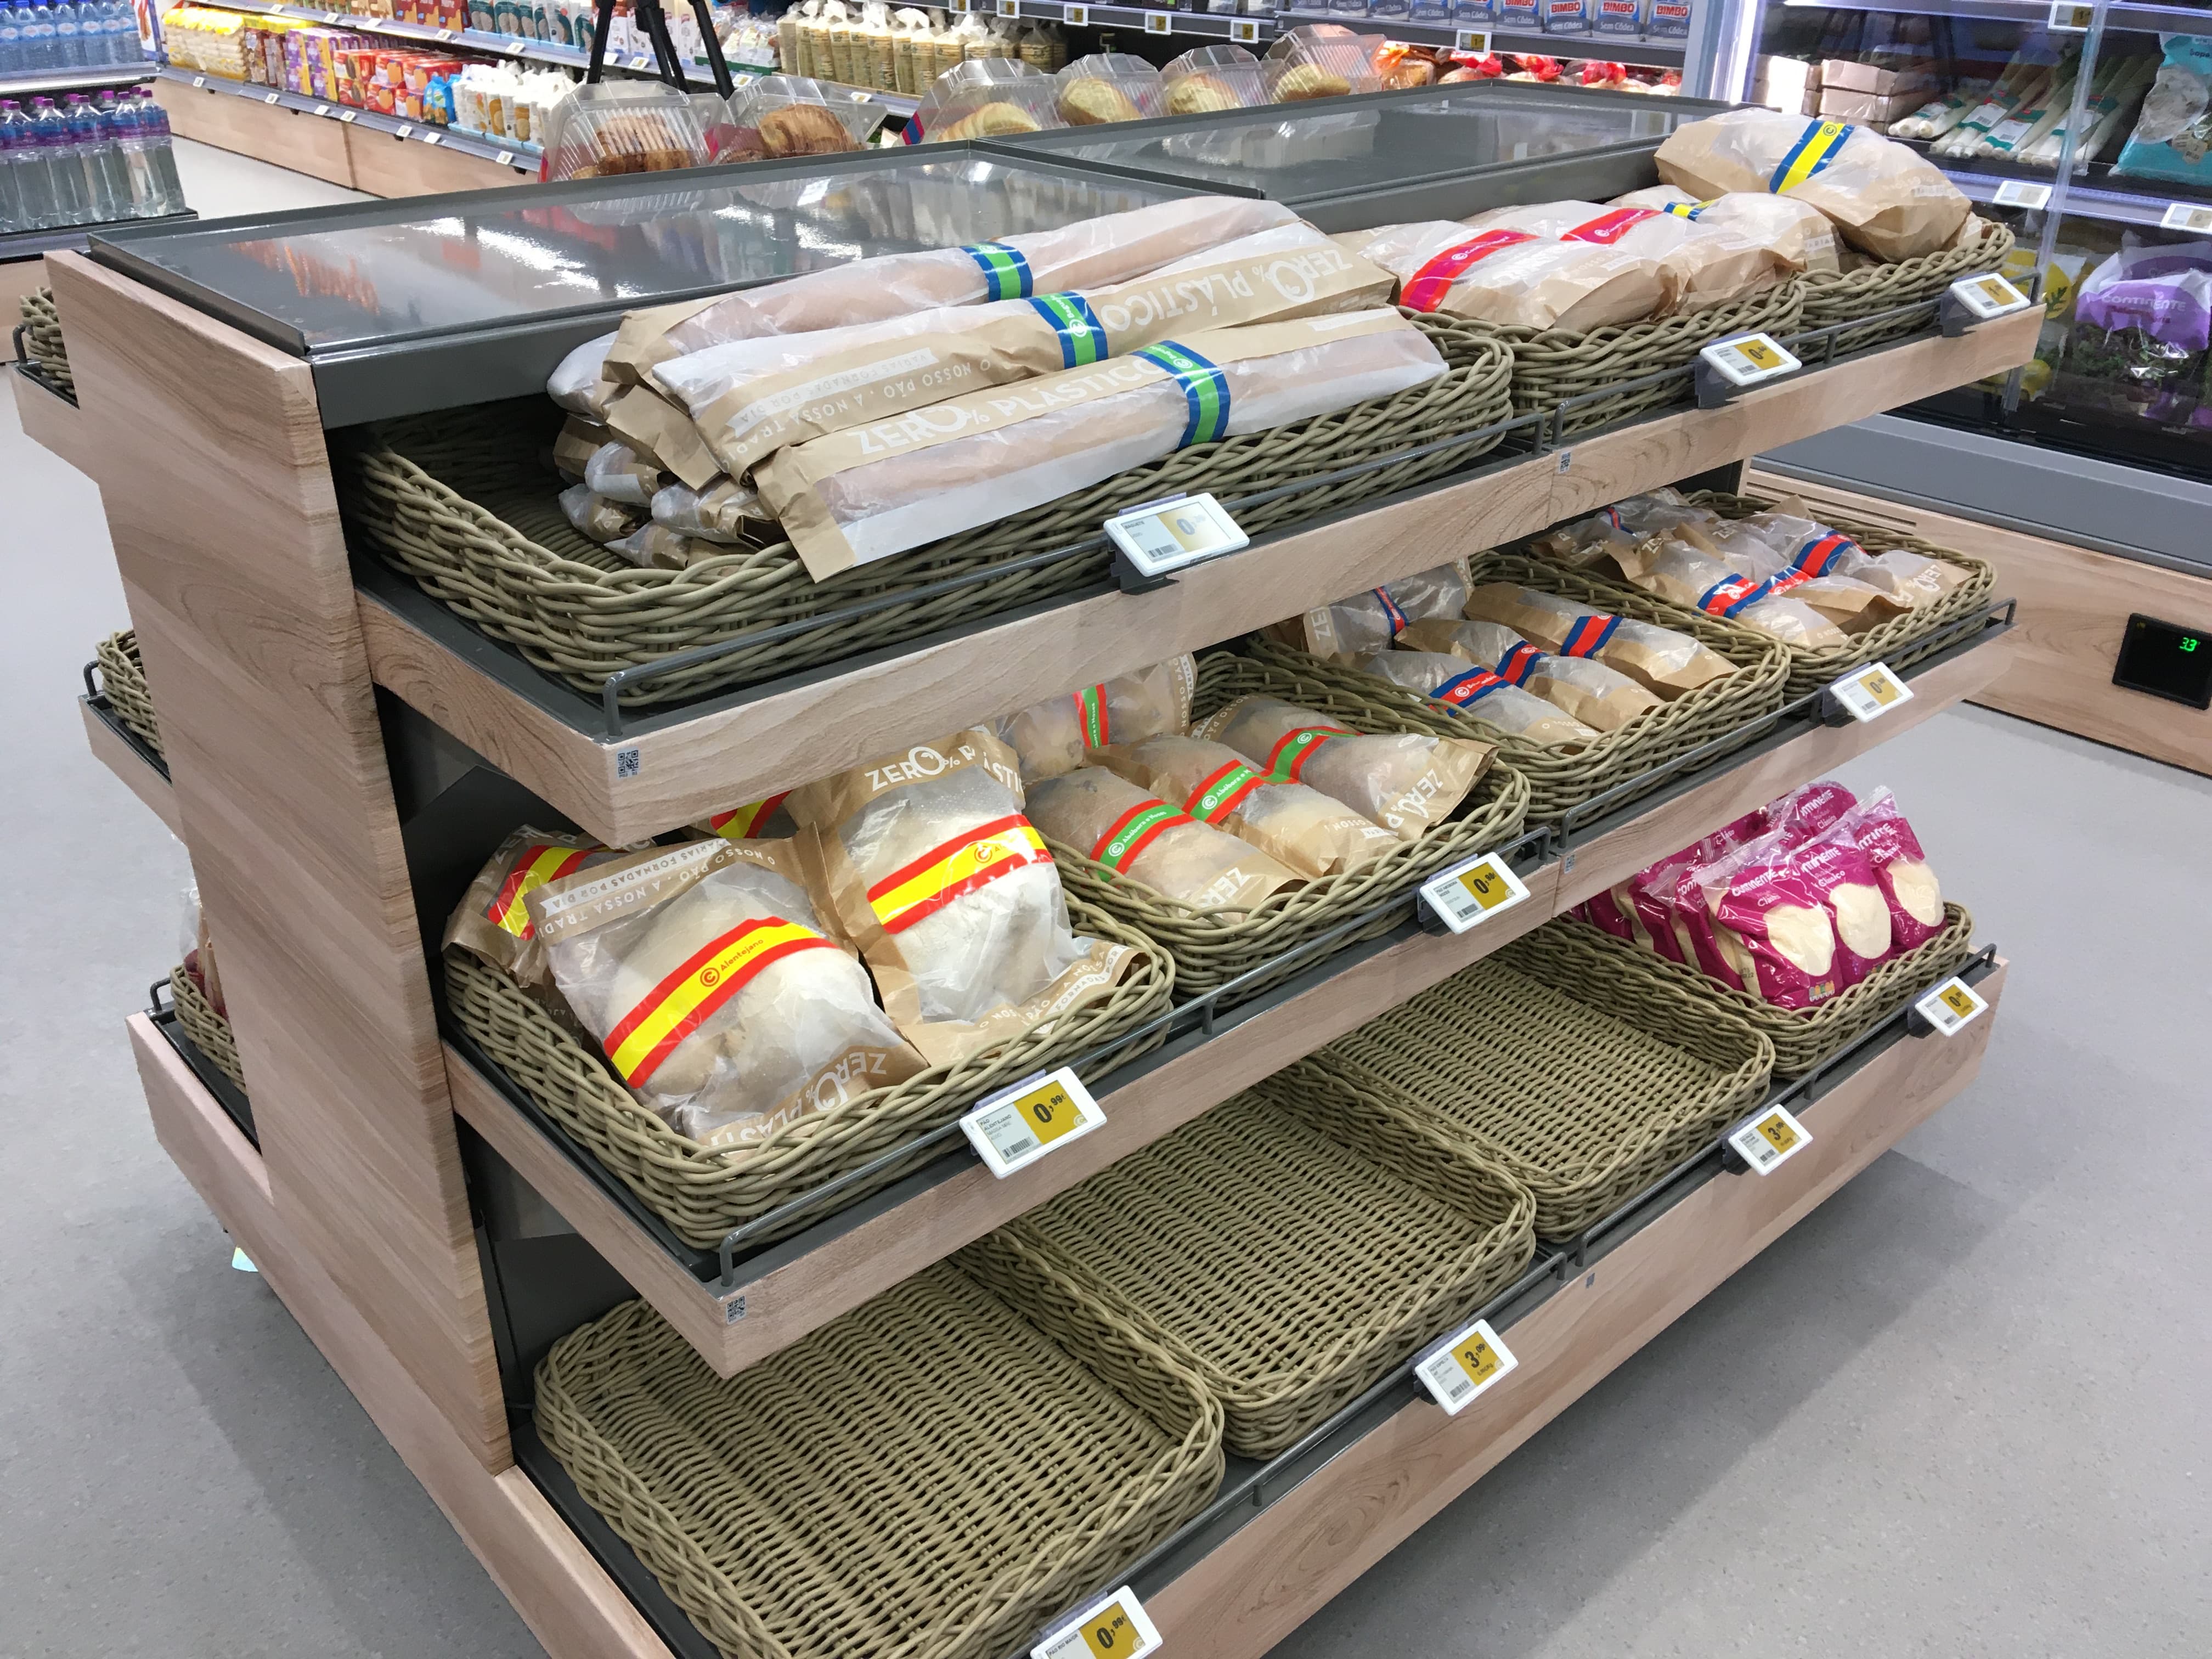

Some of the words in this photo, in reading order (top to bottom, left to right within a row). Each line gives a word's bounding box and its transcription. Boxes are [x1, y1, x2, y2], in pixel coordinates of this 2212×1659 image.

[1471, 10, 1488, 20] Códea
[1551, 2, 1581, 13] BIMBO
[1602, 1, 1634, 13] BIMBO
[1656, 4, 1688, 16] BIMBO
[1516, 15, 1534, 25] Códea
[1551, 22, 1562, 31] Sem
[1564, 21, 1583, 30] Códea
[1600, 21, 1613, 30] Sem
[1615, 21, 1634, 31] Códea
[1101, 269, 1254, 331] PLÁSTICO
[922, 362, 971, 385] NOSSO
[807, 369, 878, 400] FORNADAS
[883, 376, 916, 398] PÃO
[988, 357, 1166, 416] PLÁSTICO
[771, 392, 802, 407] POR
[740, 404, 767, 423] DIA
[791, 399, 849, 425] NOSSA
[865, 747, 960, 792] ZERO%
[1216, 776, 1241, 797] Abóbora
[1122, 816, 1146, 843] Abóbora
[715, 848, 764, 864] NOSSO
[768, 855, 776, 865] O
[611, 855, 678, 887] FORNADAS
[680, 865, 711, 882] PÃO
[579, 882, 607, 898] POR
[654, 879, 661, 891] A
[551, 893, 577, 909] DIA
[593, 888, 647, 915] NOSSA
[720, 939, 764, 972] Alentejano
[1025, 1000, 1051, 1020] PÃO
[1073, 951, 1105, 977] NOSSA
[1055, 975, 1105, 1011] FORNADAS
[1033, 1093, 1066, 1124] 0,99€
[984, 1114, 1012, 1132] ALENTEJANO
[1065, 1633, 1079, 1645] MAIOR
[1096, 1615, 1126, 1649] 0,99€
